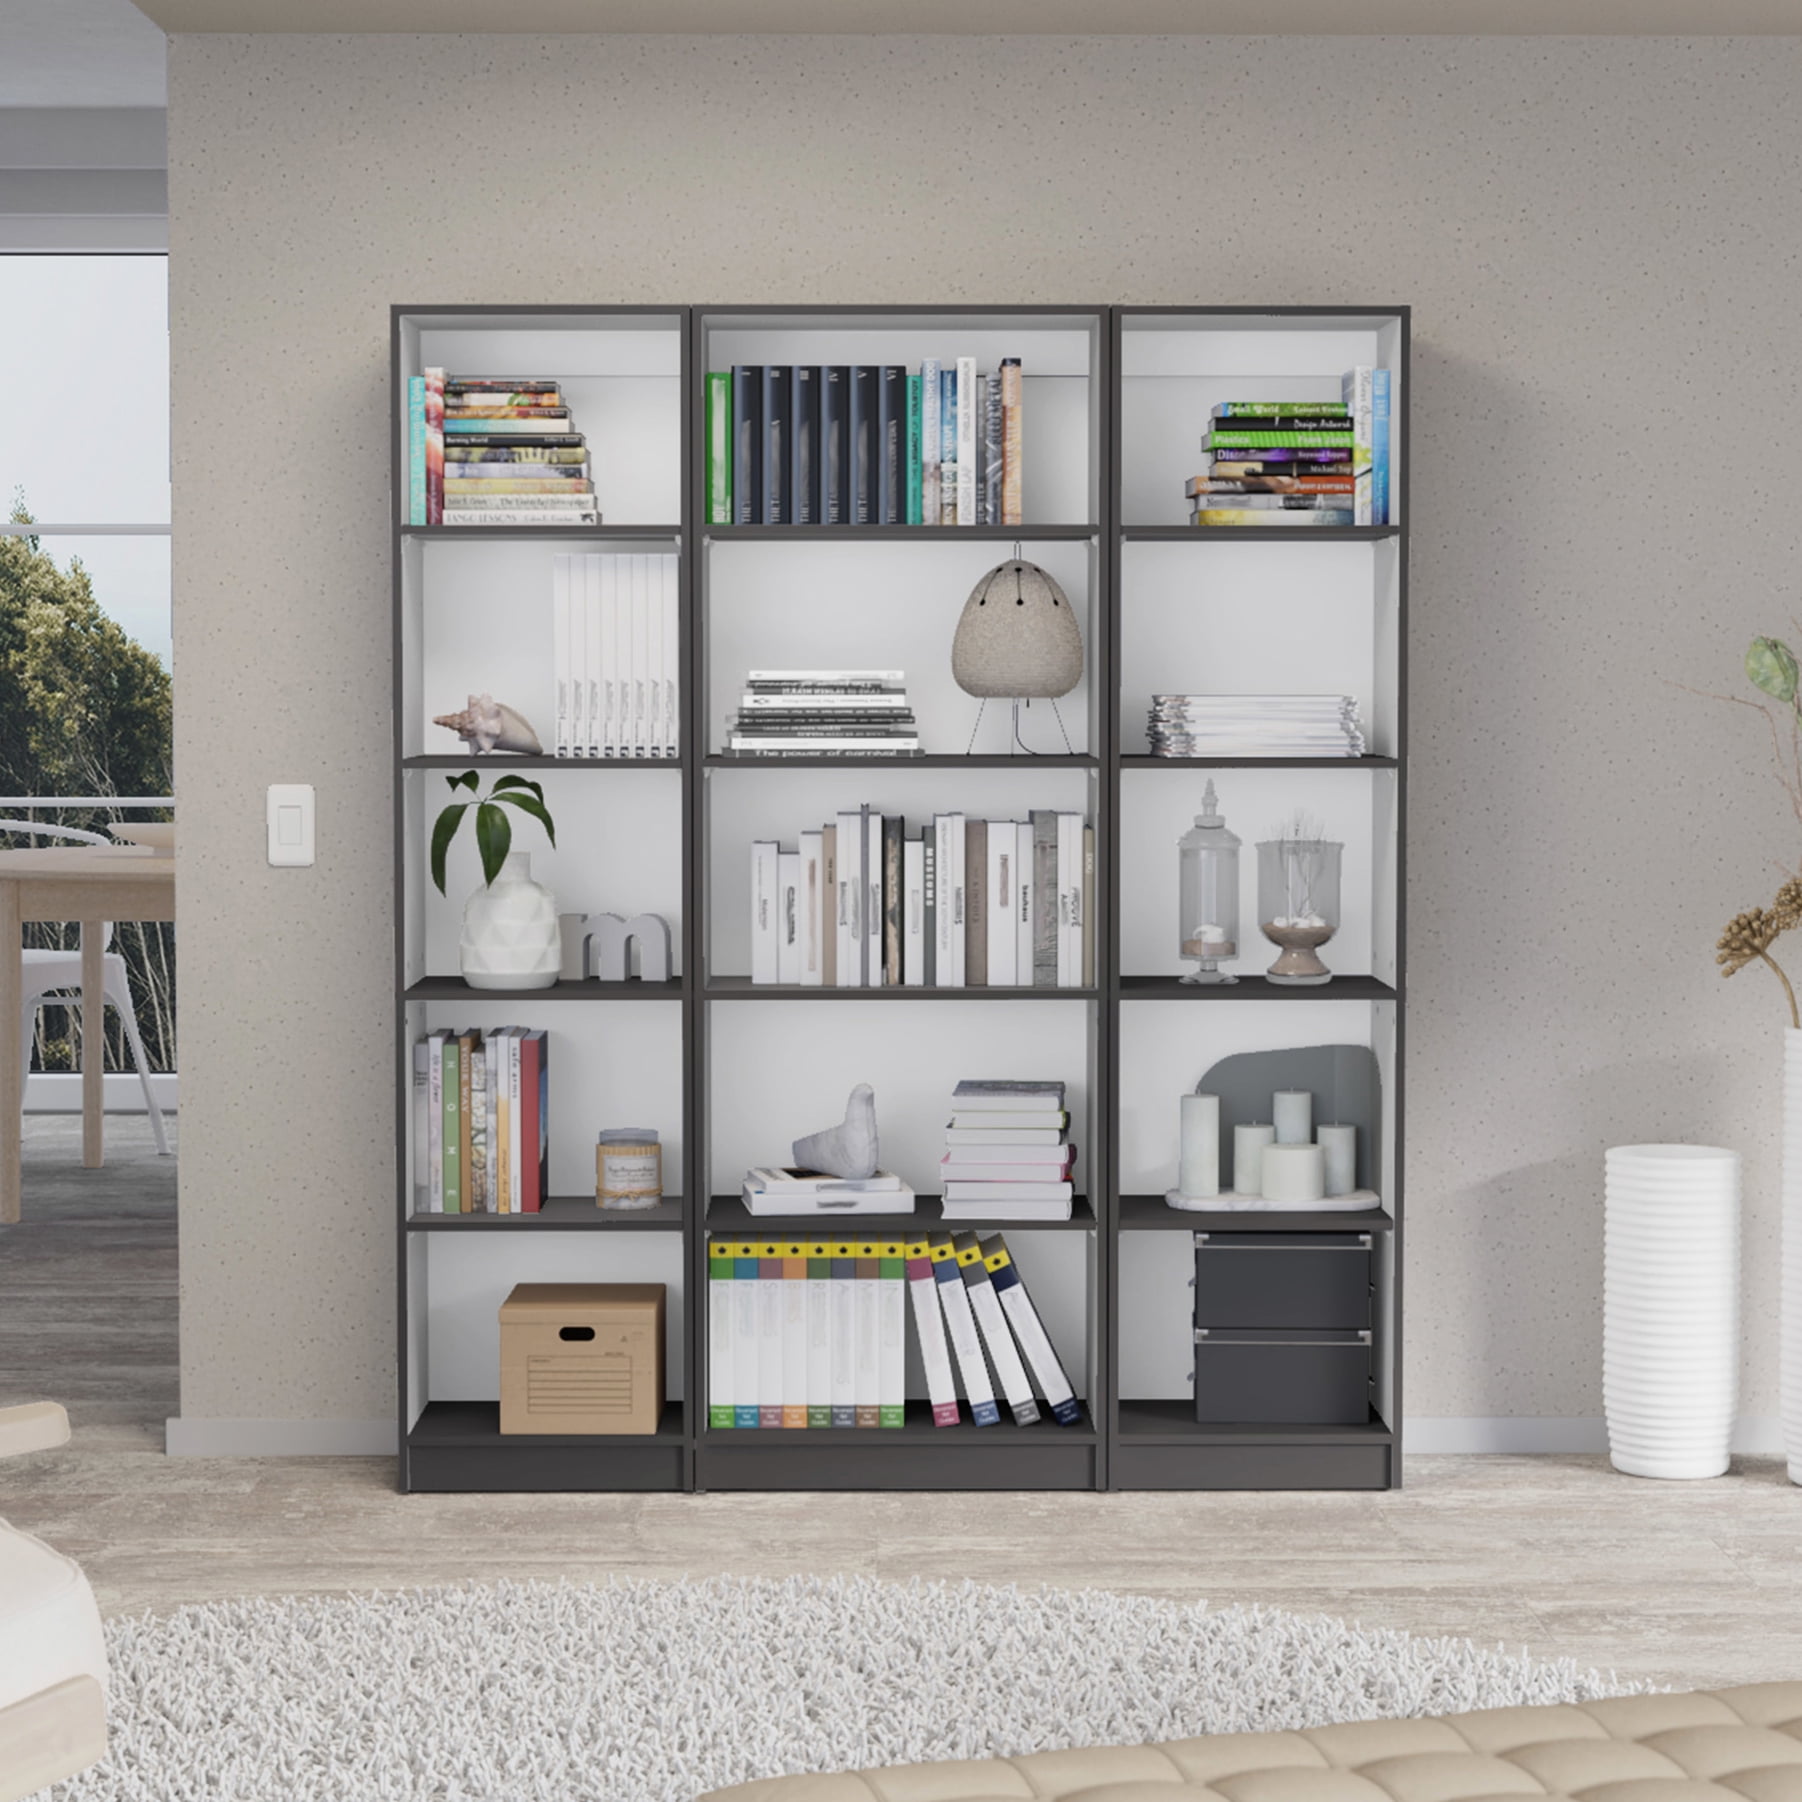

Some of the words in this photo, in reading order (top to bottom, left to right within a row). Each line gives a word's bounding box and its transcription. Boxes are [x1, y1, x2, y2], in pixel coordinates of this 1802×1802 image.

[829, 371, 838, 382] IV
[1253, 403, 1279, 414] World
[782, 750, 822, 758] power
[926, 848, 934, 907] MUSEUMS
[461, 1045, 469, 1081] YOUR
[512, 1047, 520, 1068] safe
[461, 1087, 469, 1113] WAY
[447, 1060, 456, 1196] HOME
